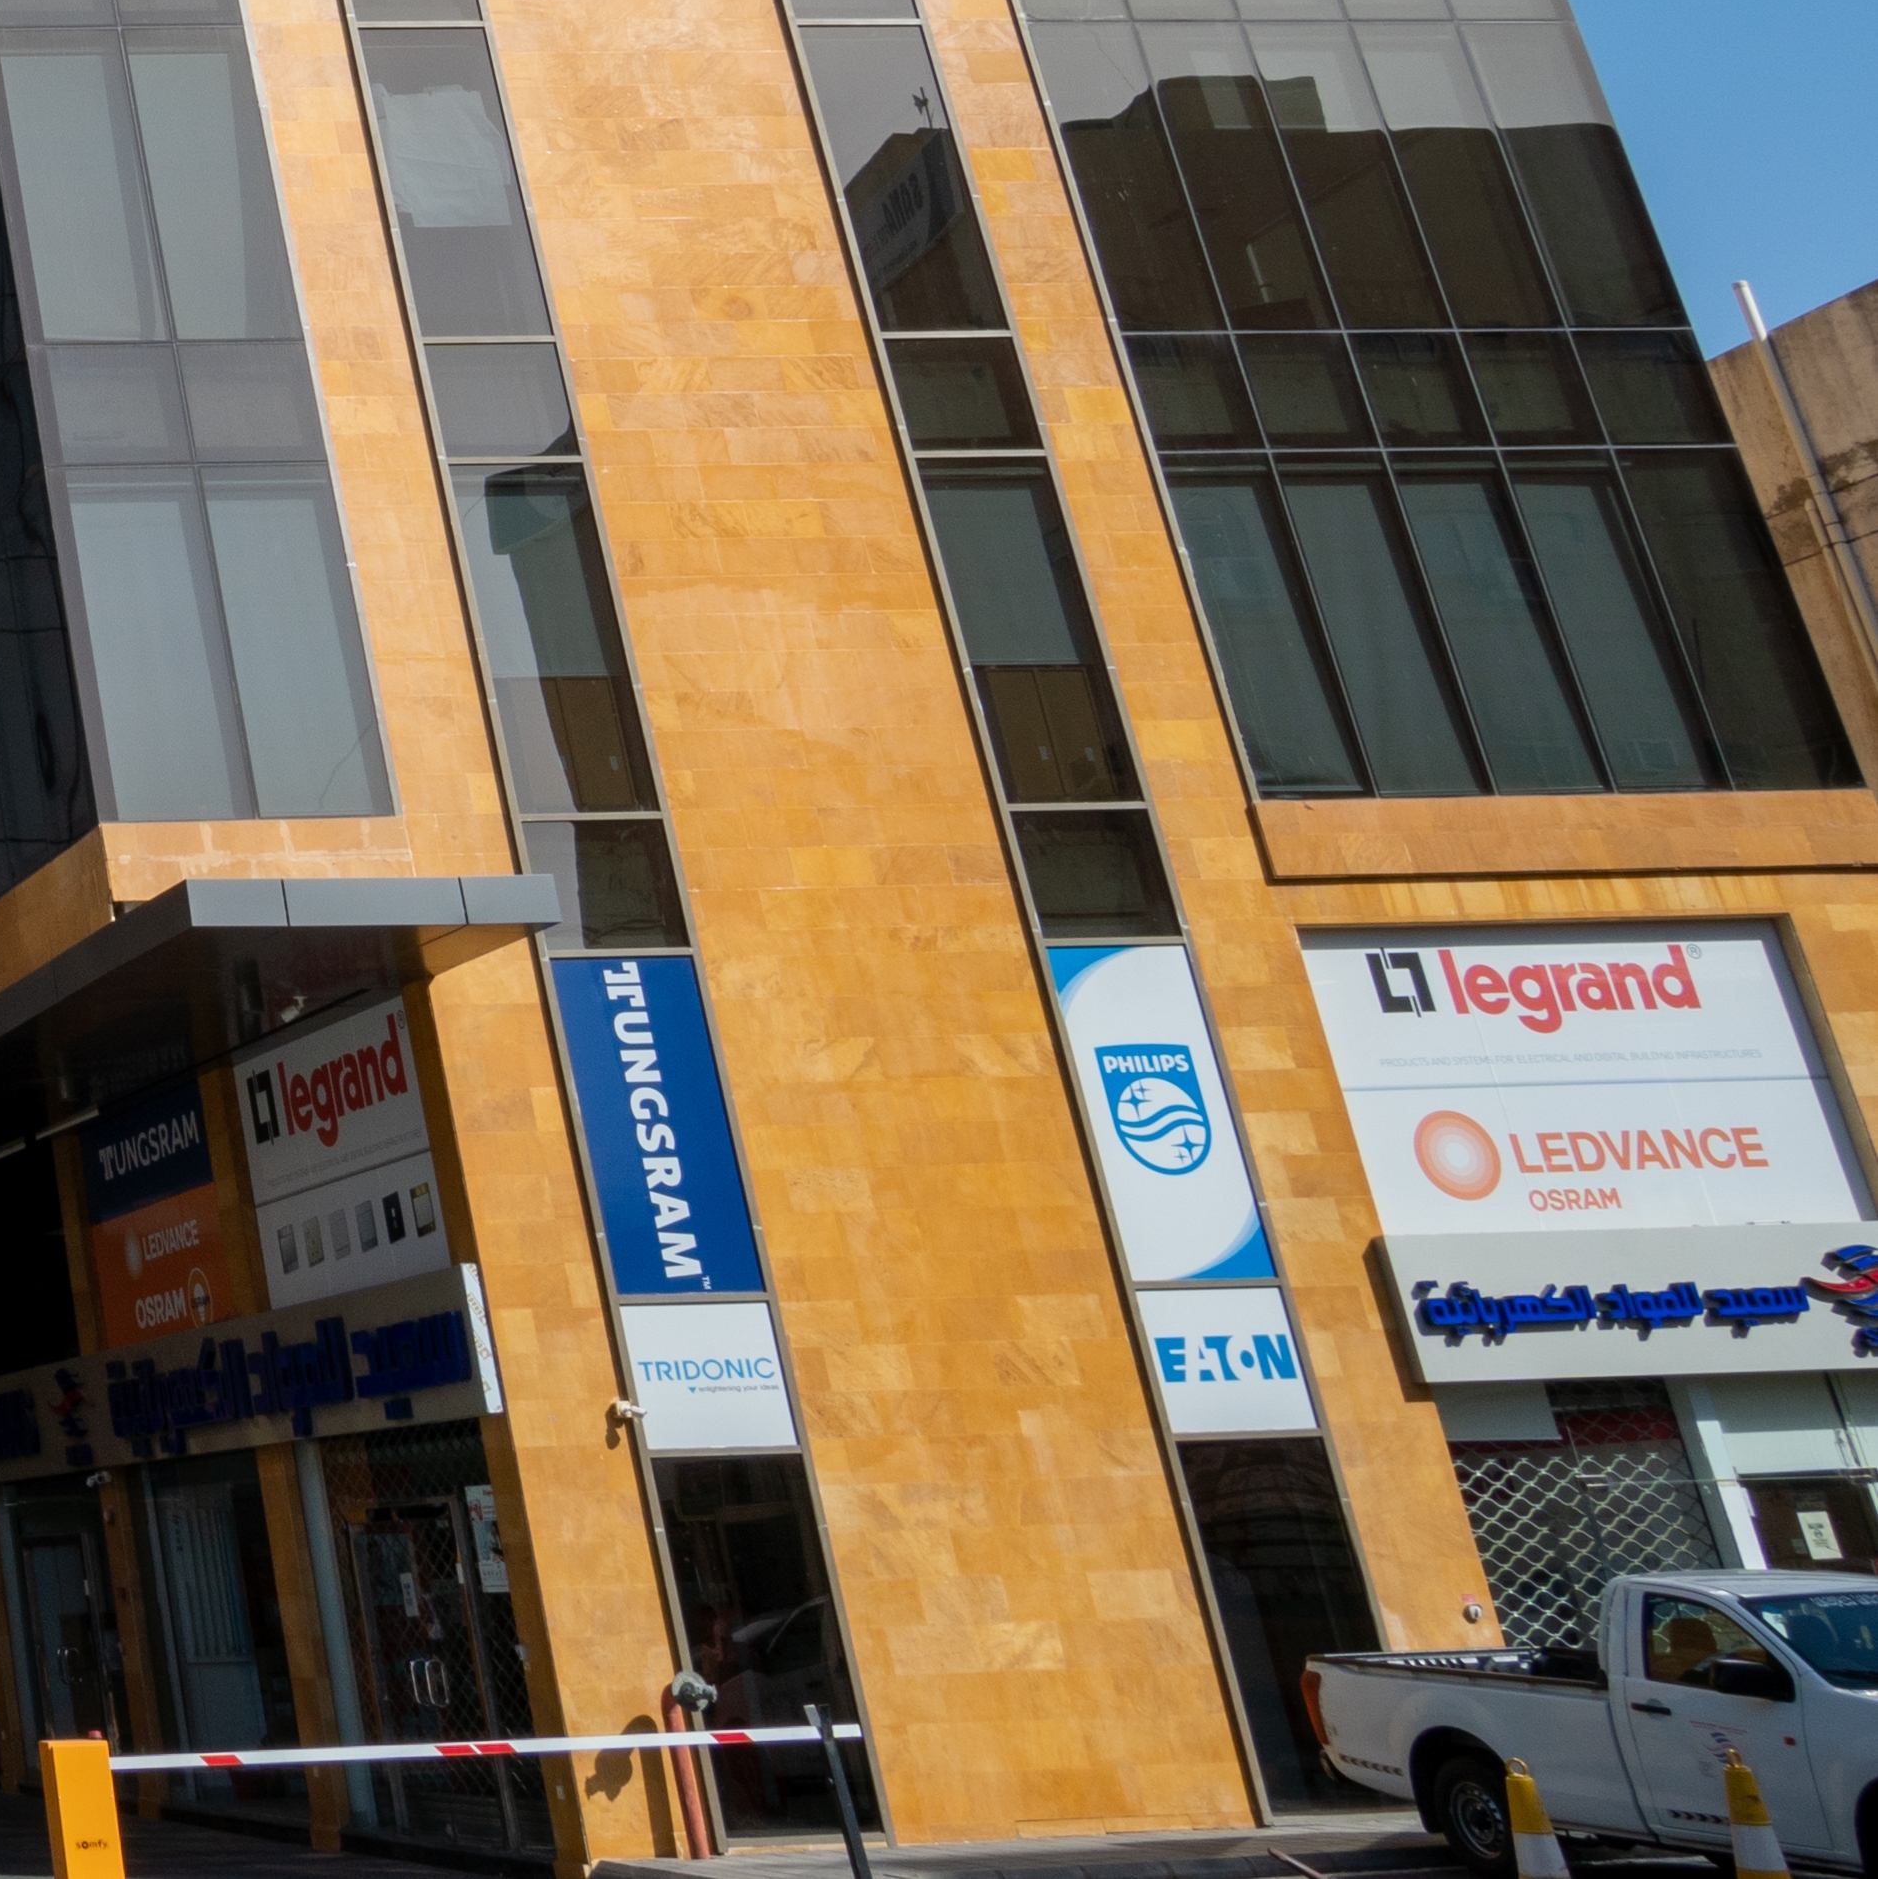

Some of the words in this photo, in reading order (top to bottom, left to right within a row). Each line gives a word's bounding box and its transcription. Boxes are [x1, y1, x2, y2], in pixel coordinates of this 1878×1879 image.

[1437, 944, 1702, 1034] legrand
[277, 1012, 409, 1148] legrand
[1102, 1053, 1190, 1074] PHILIPS
[1380, 1057, 1430, 1068] PRODUCTS
[1431, 1056, 1452, 1067] AND
[1453, 1055, 1494, 1066] SYSTEMS
[1495, 1054, 1514, 1065] FOR
[1517, 1053, 1572, 1064] ELECTRICAL
[1573, 1052, 1593, 1063] AND
[1594, 1052, 1628, 1062] DIGITAL
[603, 961, 703, 1279] TUNGSRAM
[98, 1110, 201, 1182] TUNGSRAM
[1508, 1127, 1770, 1174] LEDVANCE
[1528, 1187, 1623, 1212] OSRAM
[141, 1219, 200, 1262] LEDVANCE
[135, 1287, 187, 1330] OSRAM
[1415, 1279, 1599, 1338] الكهربائية
[1597, 1281, 1705, 1333] للمواد
[1707, 1284, 1810, 1332] سعيد
[637, 1357, 776, 1382] TRIDONIC
[1154, 1334, 1298, 1383] EATON
[699, 1384, 741, 1394] enlightening
[760, 1383, 779, 1391] ideas
[76, 1839, 108, 1850] somfy
